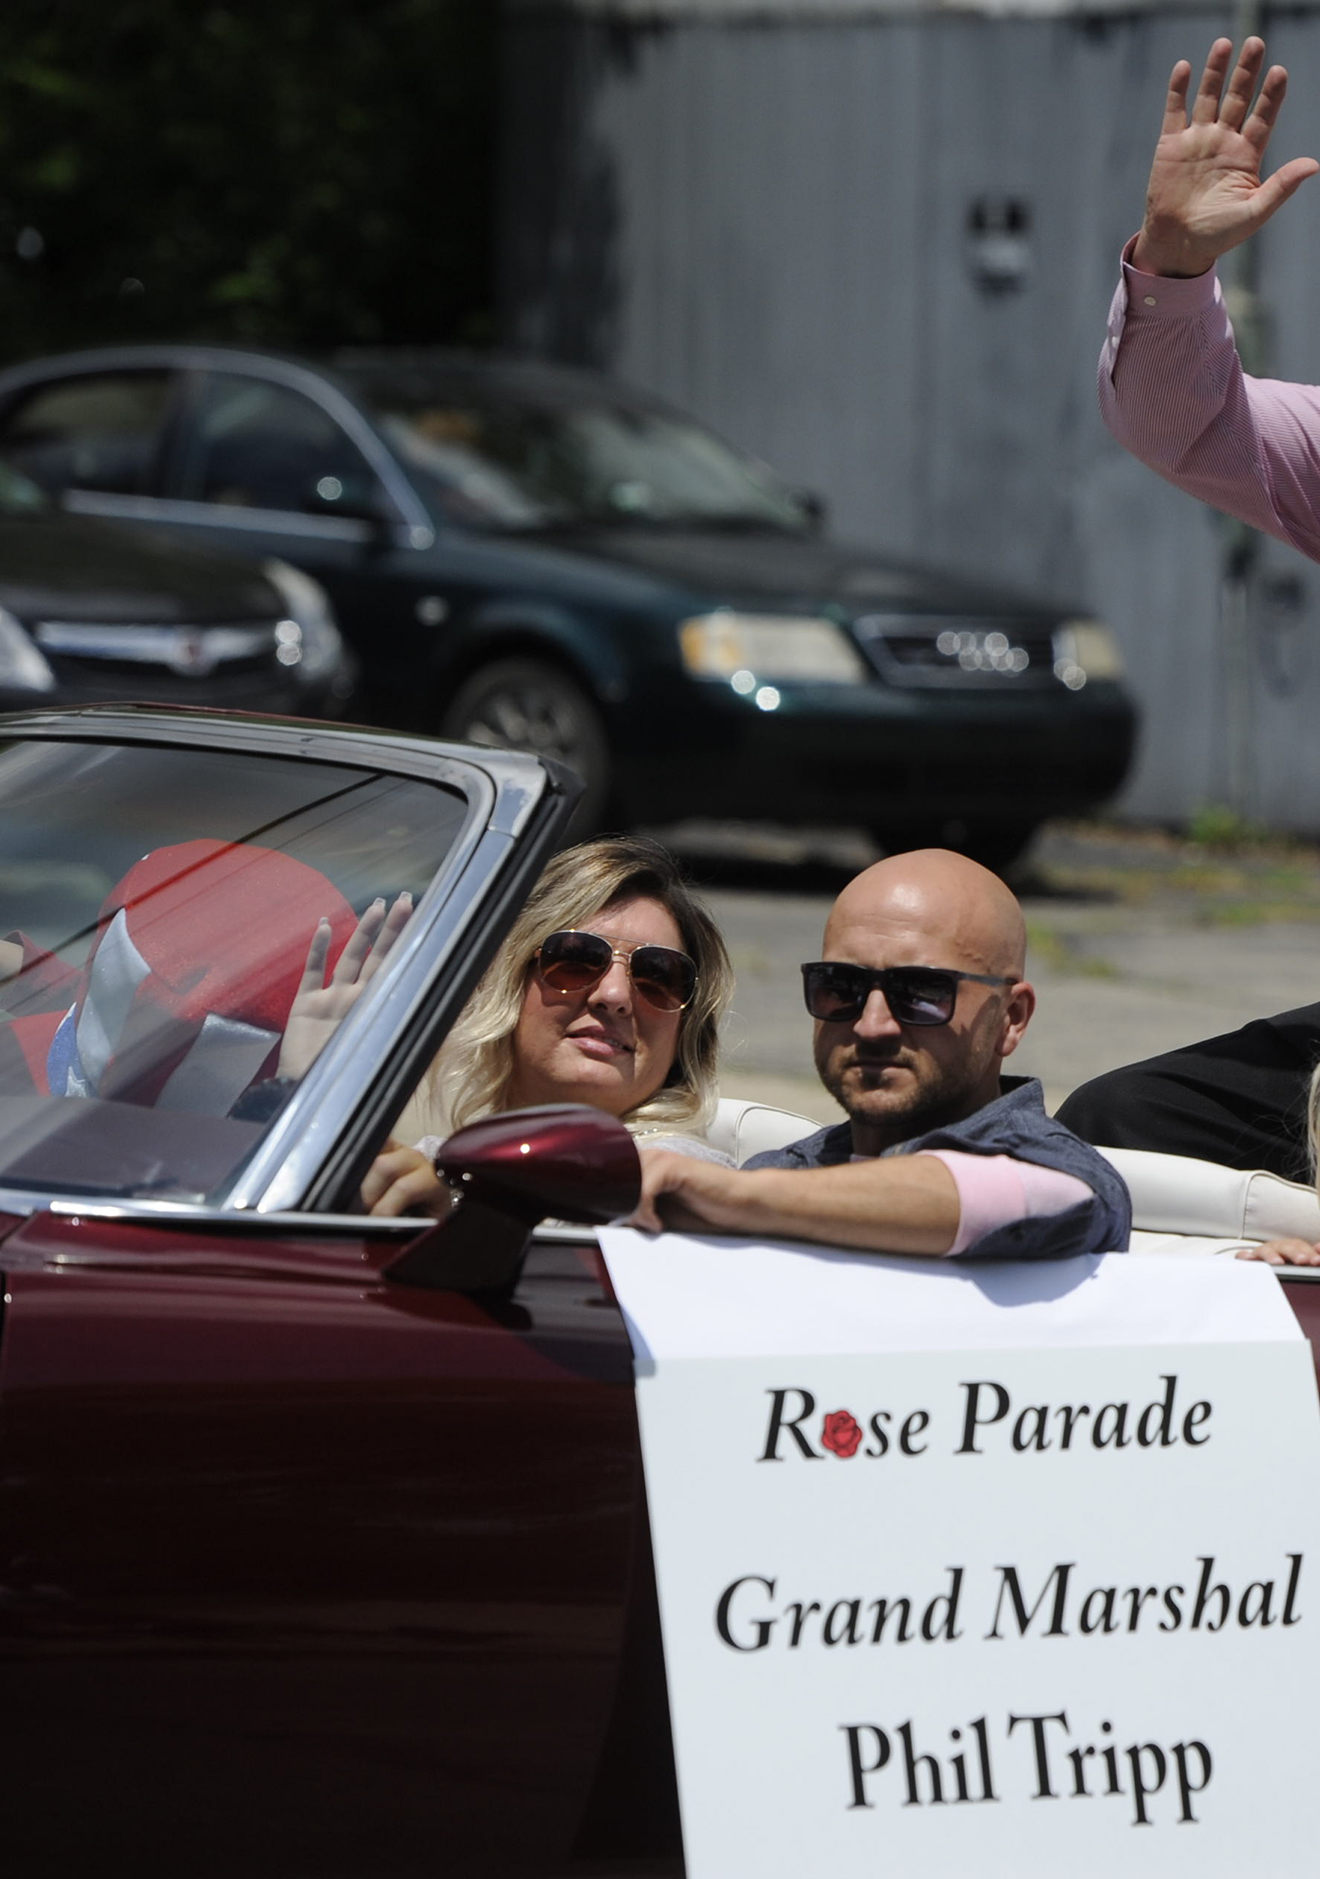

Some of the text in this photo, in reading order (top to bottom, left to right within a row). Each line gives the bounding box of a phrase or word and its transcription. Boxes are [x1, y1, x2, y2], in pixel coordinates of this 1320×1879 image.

[955, 1375, 1213, 1454] Parade
[715, 1553, 1304, 1652] Grand Marshal
[841, 1710, 1213, 1826] Phil Tripp
